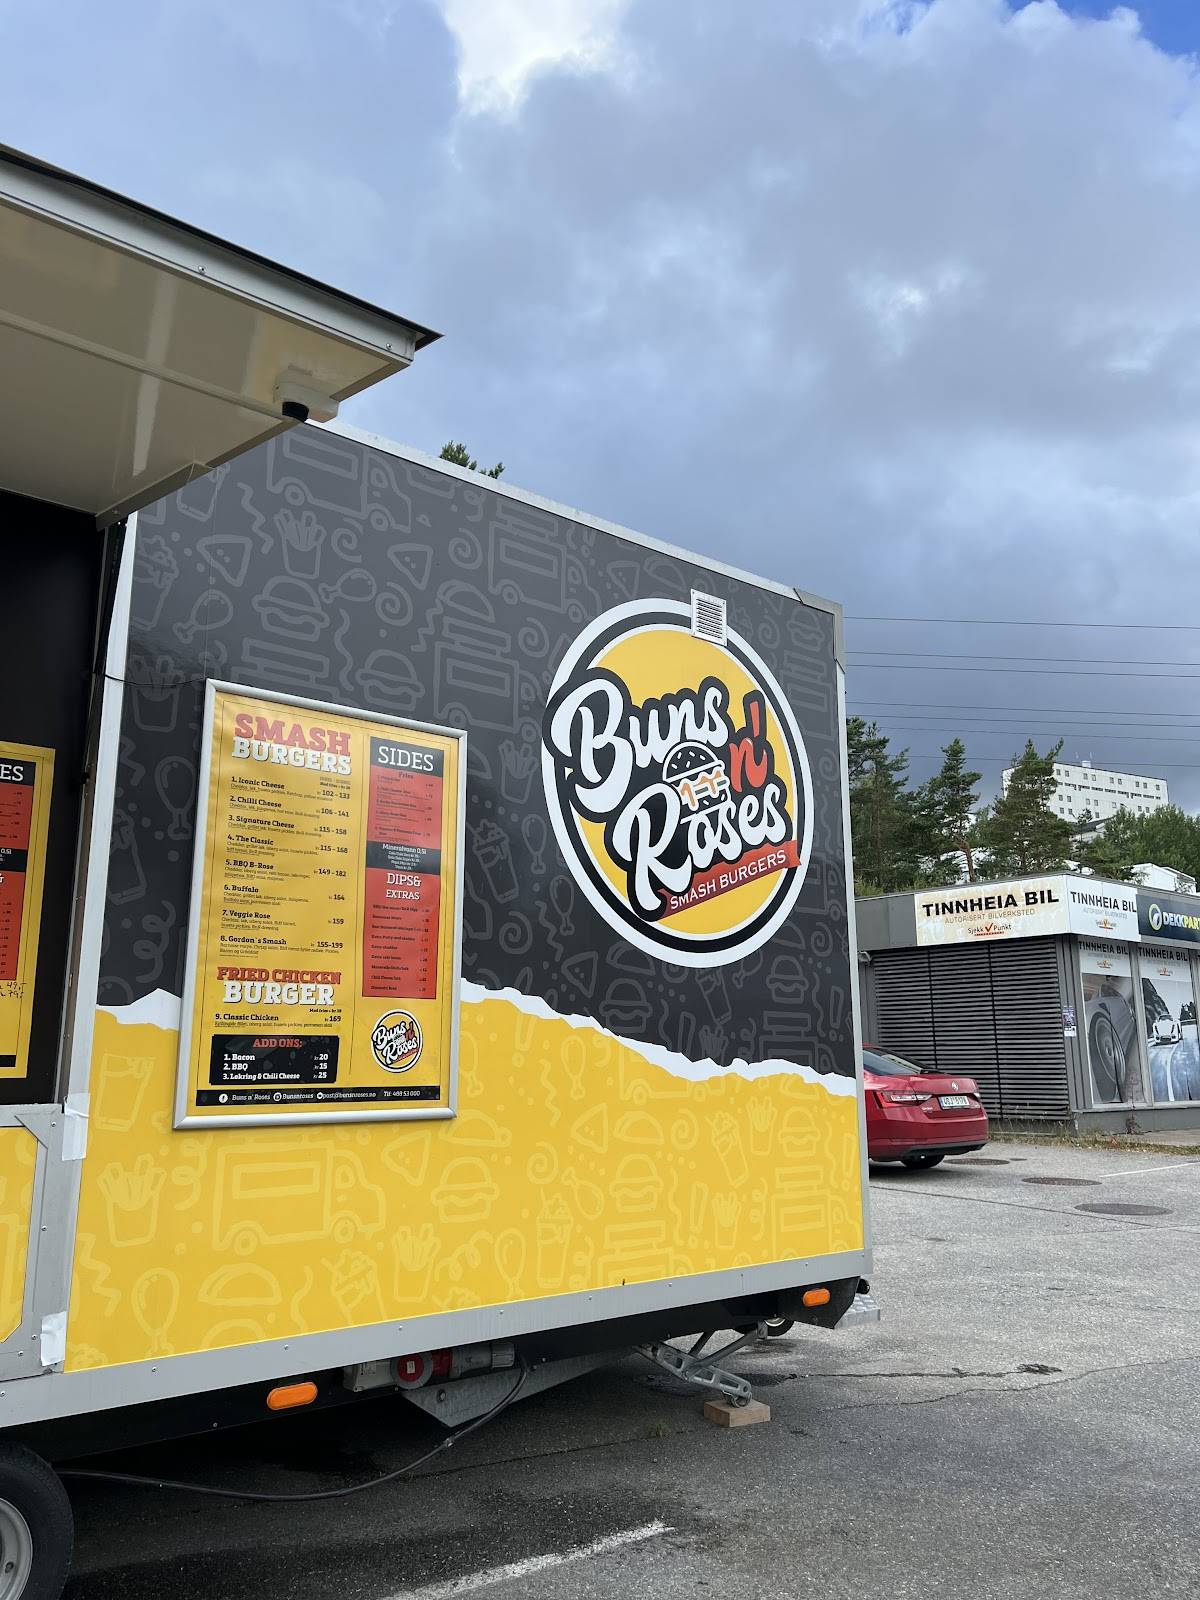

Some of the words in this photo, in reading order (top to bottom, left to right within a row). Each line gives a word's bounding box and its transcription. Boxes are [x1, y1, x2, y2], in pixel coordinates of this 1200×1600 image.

[234, 713, 352, 757] SMASH
[550, 678, 728, 814] Buns
[231, 736, 352, 776] BURGERS
[378, 746, 434, 772] SIDES
[238, 777, 260, 786] Iconic
[261, 780, 285, 790] Cheese
[237, 797, 258, 805] Chilli
[258, 800, 282, 808] Cheese
[236, 815, 271, 826] Signature
[272, 820, 295, 829] Cheese
[250, 837, 274, 846] Classic
[612, 782, 786, 911] Roses
[233, 860, 248, 868] BBQ
[250, 861, 274, 870] B-Rose
[670, 876, 717, 910] SMASH
[720, 850, 787, 888] BURGERS
[232, 885, 259, 893] Buffalo
[386, 889, 420, 900] EXTRAS
[922, 894, 1018, 916] TINNHEIA
[1024, 890, 1060, 906] BIL
[1070, 891, 1119, 910] TINNHEIA
[1122, 900, 1137, 913] BIL
[229, 910, 253, 919] Veggie
[945, 914, 985, 924] AUTORISERT
[988, 908, 1035, 920] BILVERKSTED
[968, 926, 983, 935] Sjekk
[1079, 941, 1114, 954] TINNHEIA
[1116, 945, 1129, 955] BIL
[1138, 947, 1174, 960] TINNHEIA
[1176, 951, 1188, 962] BIL
[217, 966, 269, 981] FRIED
[272, 969, 342, 984] CHICKEN
[223, 980, 334, 1005] BURGER
[253, 1038, 279, 1048] ADD
[279, 1039, 303, 1048] ONS:
[372, 1022, 406, 1049] Buns
[382, 1037, 418, 1065] Roses
[232, 1063, 248, 1071] BBQ
